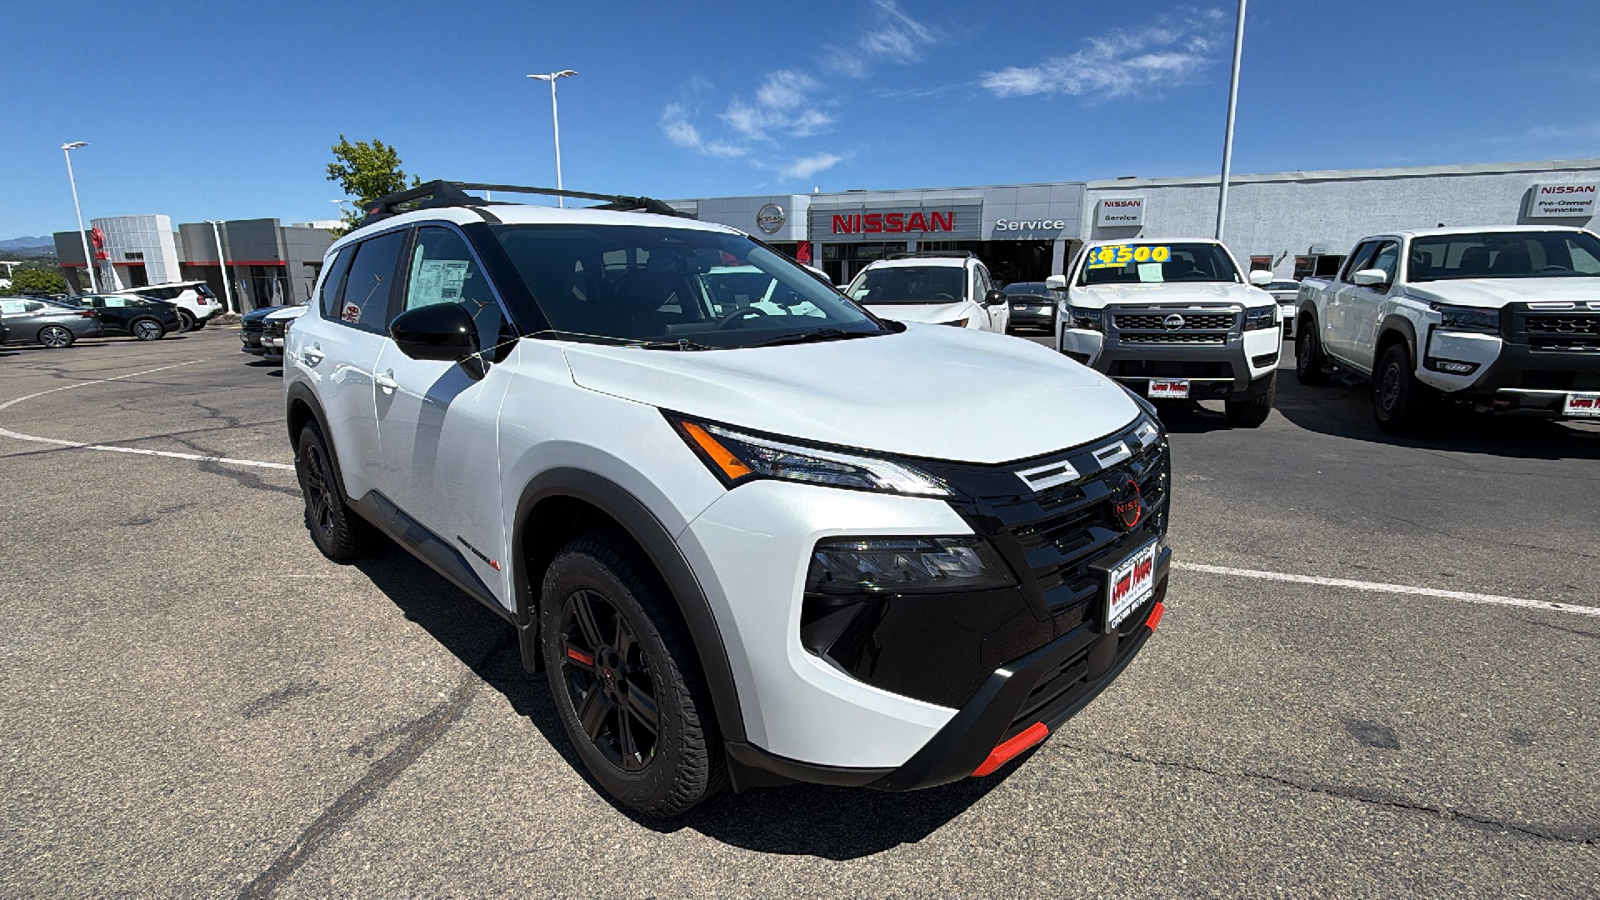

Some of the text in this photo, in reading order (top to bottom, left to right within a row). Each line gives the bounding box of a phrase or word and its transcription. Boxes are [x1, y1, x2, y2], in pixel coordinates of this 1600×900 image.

[1541, 185, 1596, 194] NISSAN
[832, 211, 954, 234] NISSAN
[996, 218, 1065, 231] Service
[1089, 246, 1169, 264] $4500
